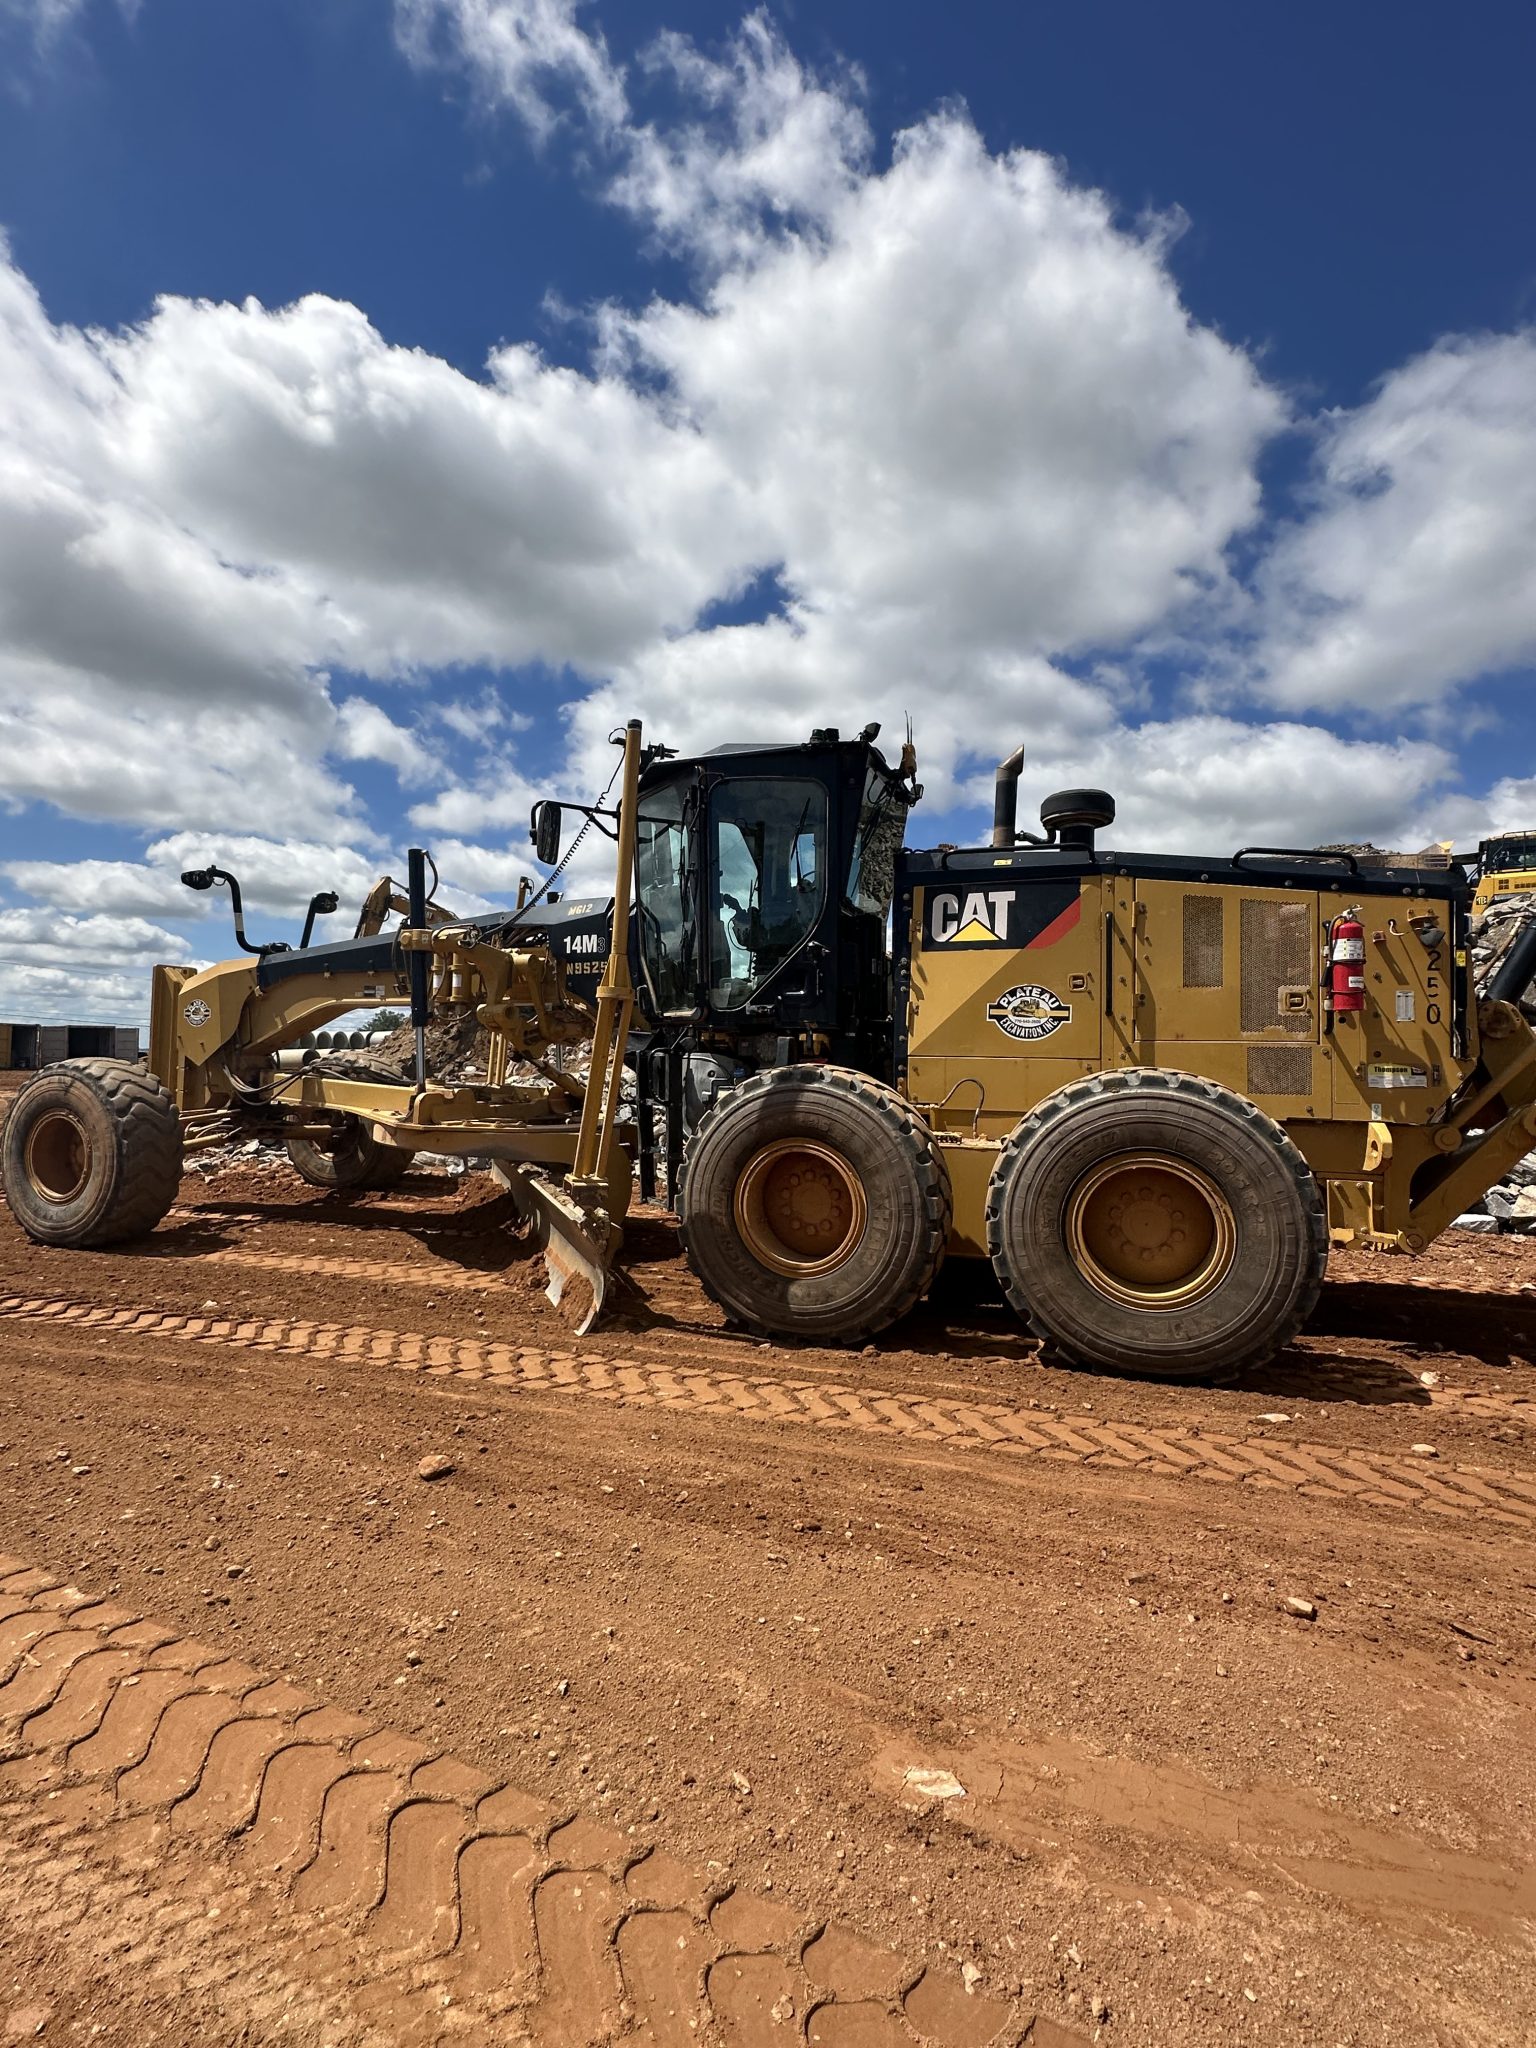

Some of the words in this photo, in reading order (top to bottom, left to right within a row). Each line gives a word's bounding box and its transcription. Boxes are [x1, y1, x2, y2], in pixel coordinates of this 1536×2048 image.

[931, 890, 1016, 942] CAT
[999, 986, 1060, 1009] PLATEAU
[1374, 1066, 1408, 1074] Thompson
